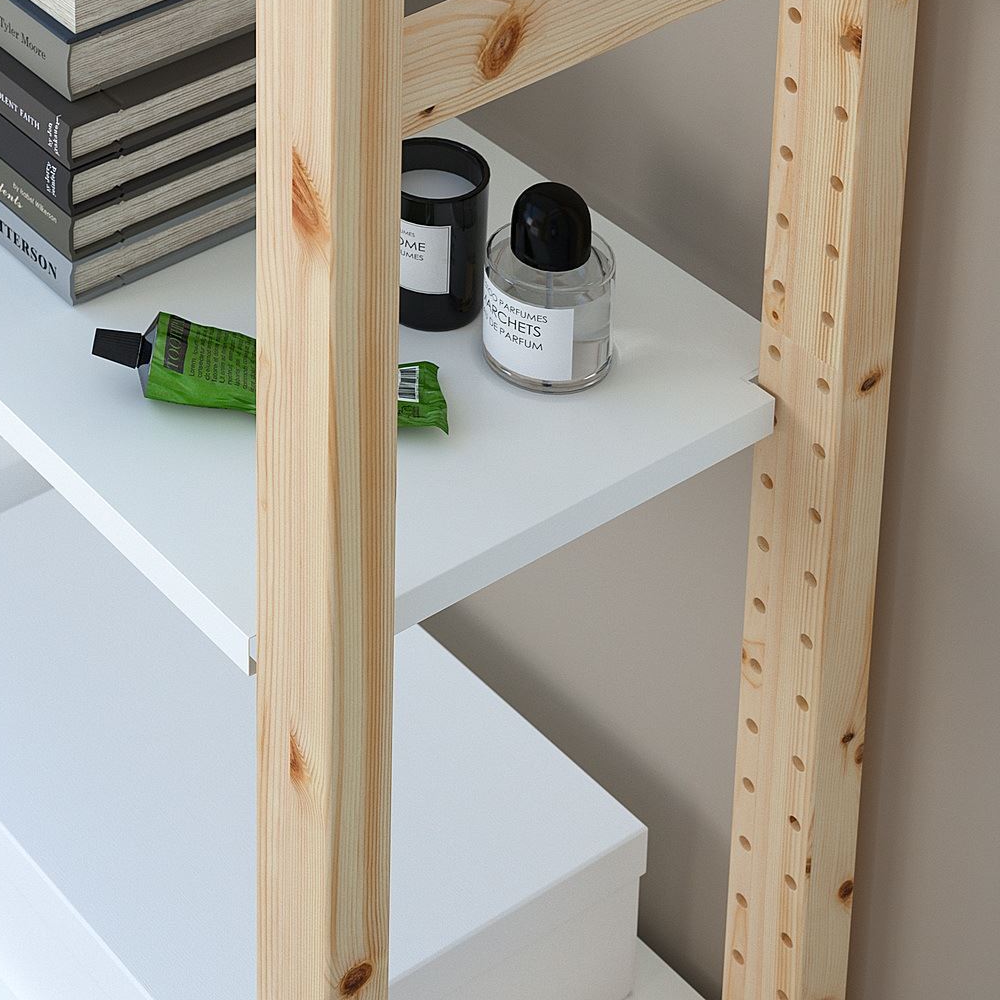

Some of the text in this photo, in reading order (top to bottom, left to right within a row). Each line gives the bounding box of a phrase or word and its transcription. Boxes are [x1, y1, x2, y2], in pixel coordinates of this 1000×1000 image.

[20, 33, 47, 60] Moore
[19, 109, 41, 131] FAITH
[499, 298, 548, 324] PARFUMES
[489, 317, 543, 351] DE PARFUM
